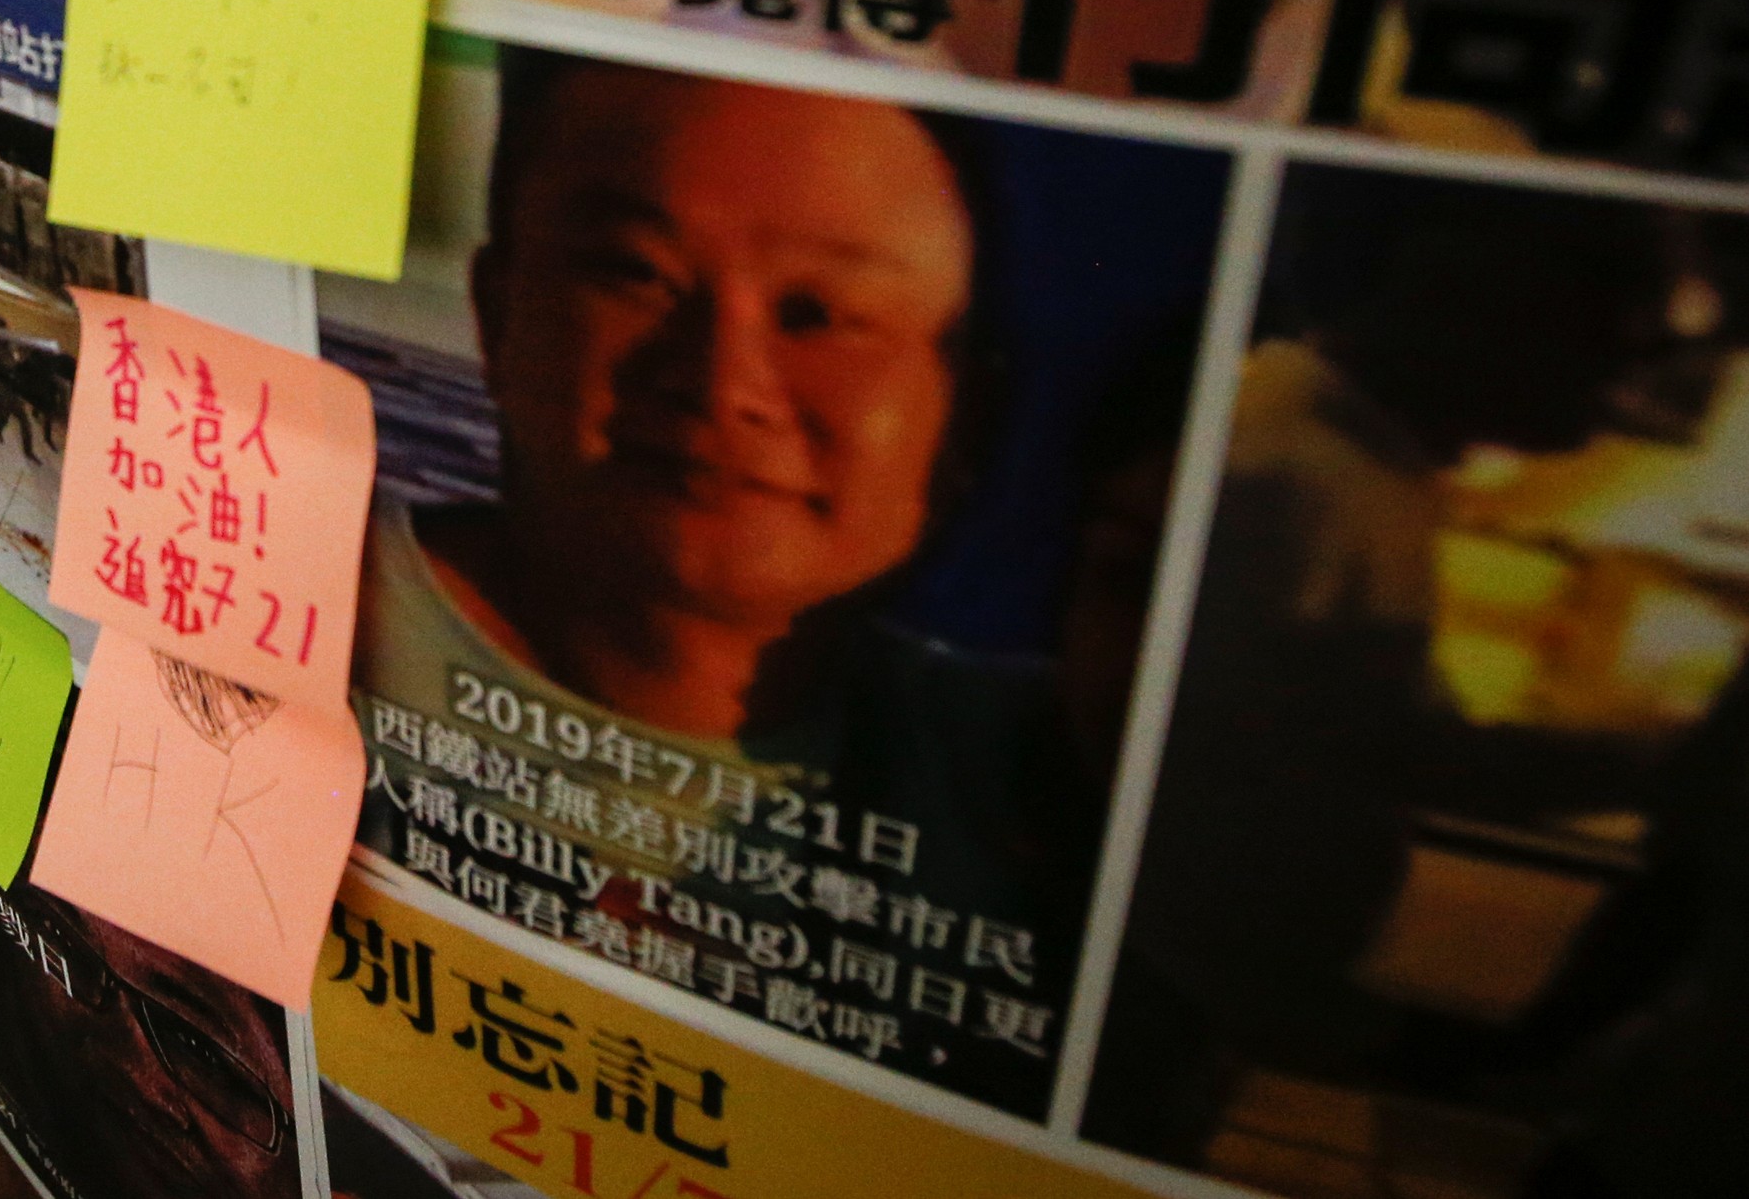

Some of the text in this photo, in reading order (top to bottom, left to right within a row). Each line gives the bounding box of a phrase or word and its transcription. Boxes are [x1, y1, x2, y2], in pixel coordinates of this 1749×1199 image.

[105, 315, 281, 479] 香港人
[103, 722, 288, 944] HK
[452, 671, 923, 877] 2019年7月21日
[327, 899, 731, 1170] 別忘記
[488, 1090, 747, 1199] 21/
